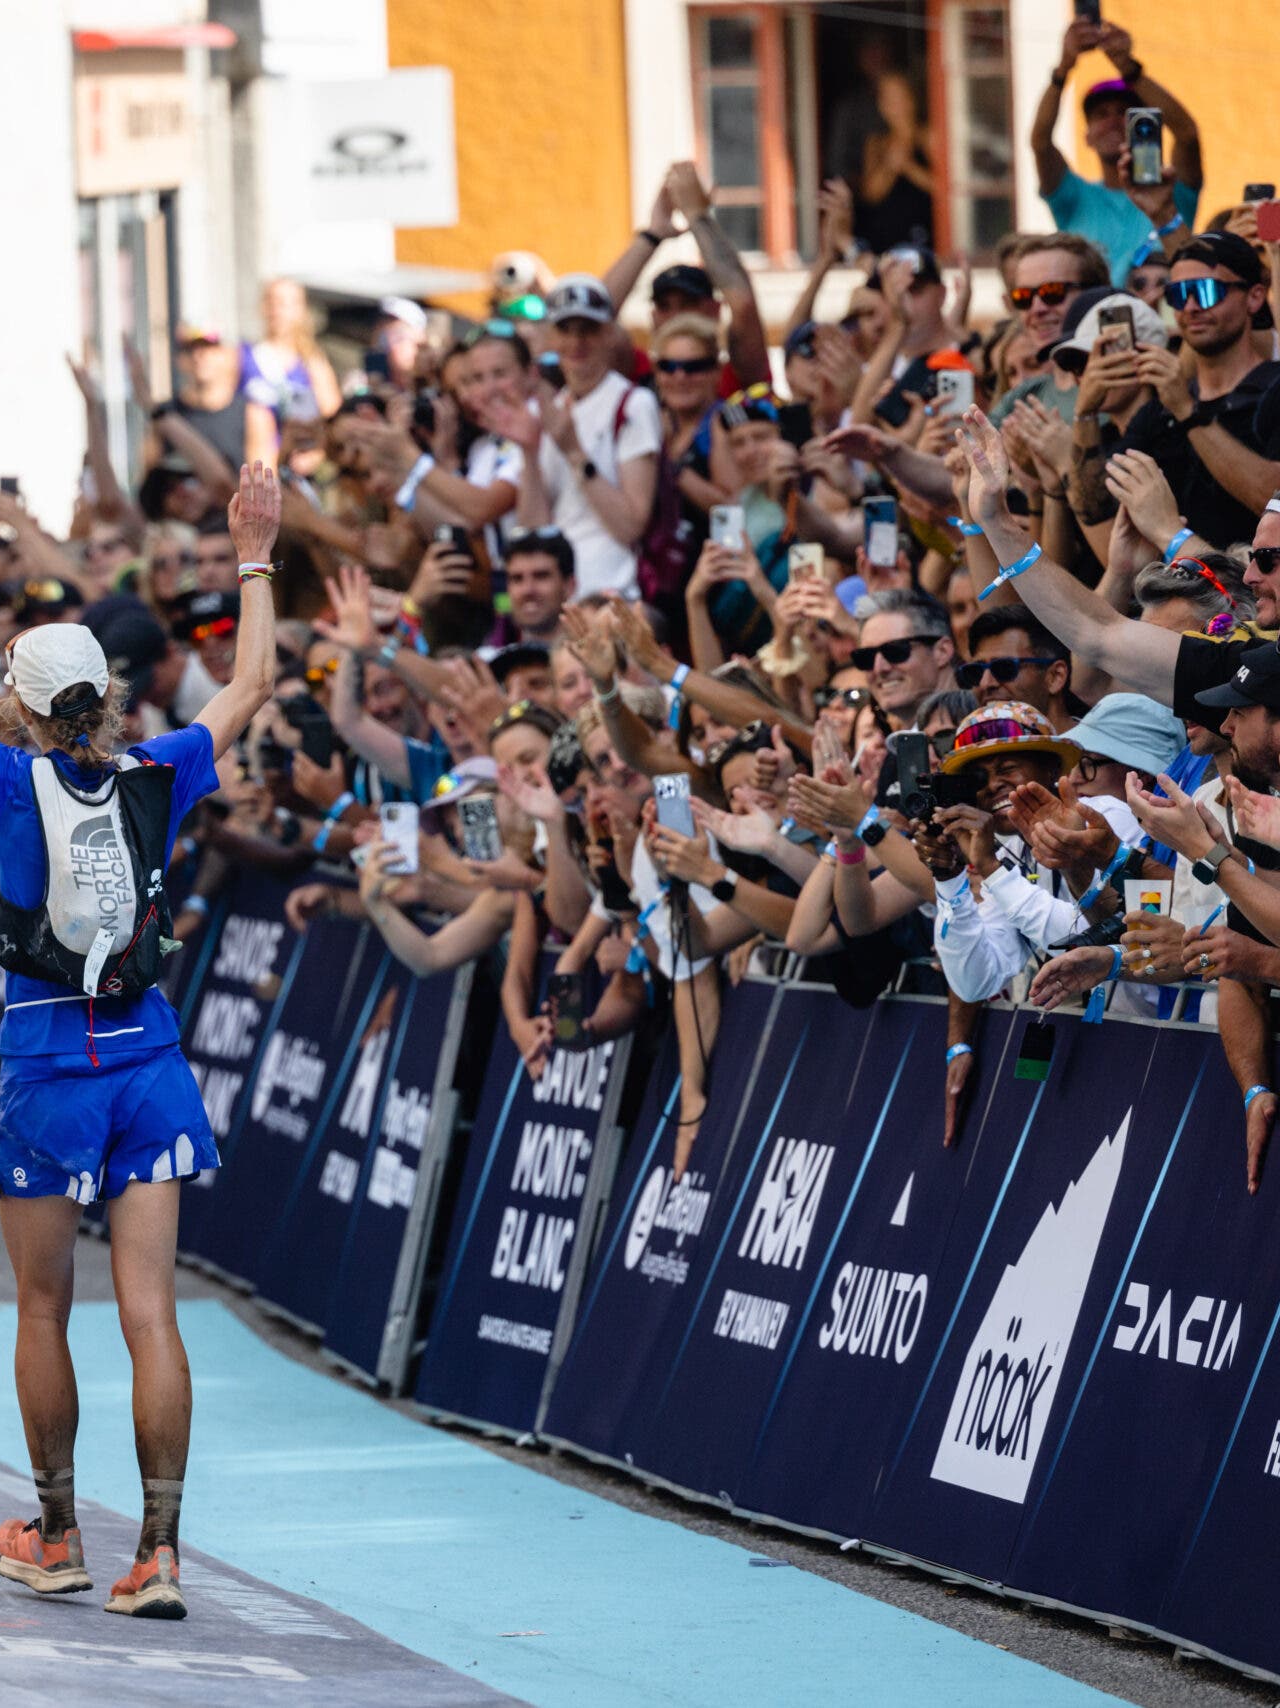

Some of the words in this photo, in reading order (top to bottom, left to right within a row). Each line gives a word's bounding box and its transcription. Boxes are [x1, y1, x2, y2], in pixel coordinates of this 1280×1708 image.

[71, 847, 94, 890] THE
[90, 848, 119, 930] NORTH
[107, 848, 133, 905] FACE
[510, 1120, 586, 1201] MONT
[737, 1136, 836, 1271] HOKA
[490, 1205, 575, 1292] BLANC
[819, 1261, 928, 1365] SUUNTO
[1112, 1281, 1243, 1371] DACIA
